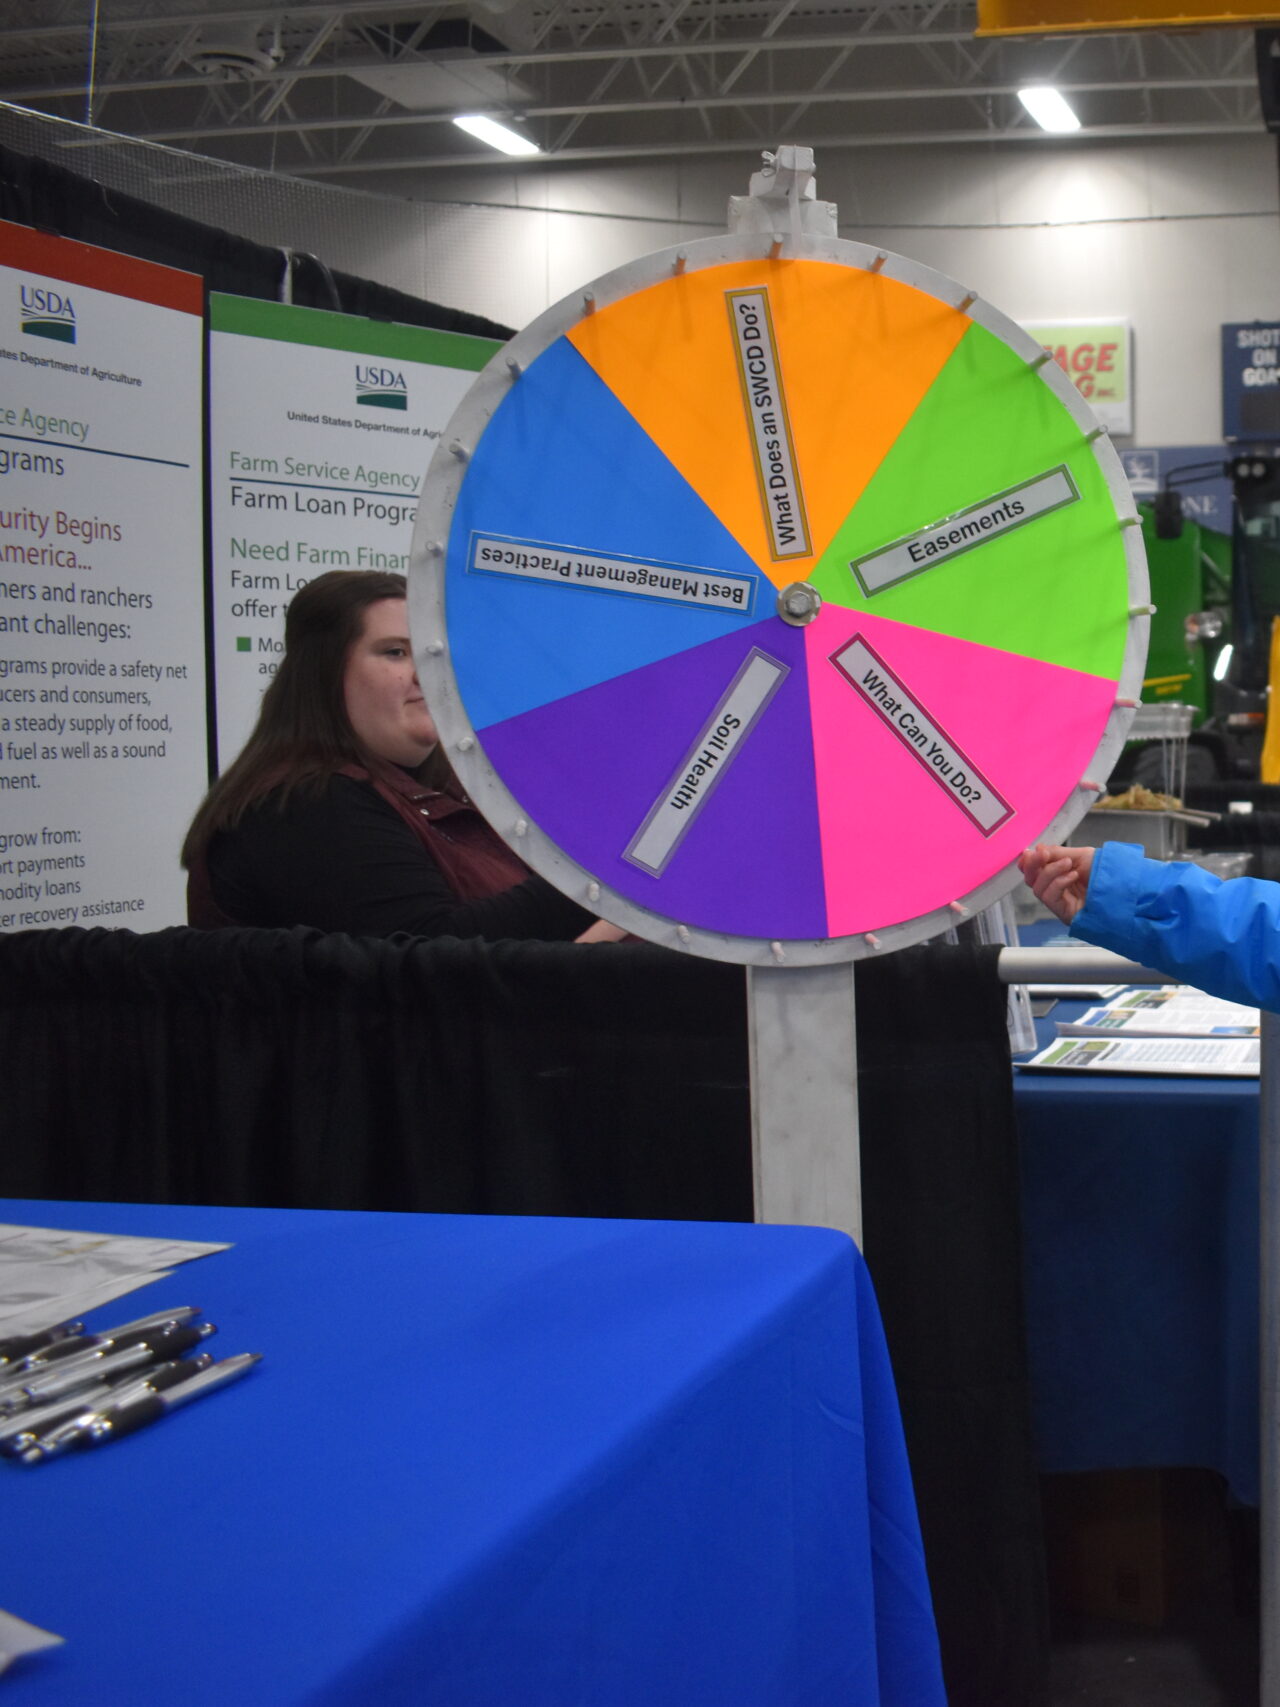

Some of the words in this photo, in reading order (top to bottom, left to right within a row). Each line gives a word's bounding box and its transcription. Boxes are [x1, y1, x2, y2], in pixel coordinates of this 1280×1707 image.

[20, 284, 76, 319] USDA
[739, 303, 761, 340] Do?
[20, 351, 78, 374] Department
[79, 365, 90, 376] of
[91, 367, 142, 387] Agriculture
[1043, 343, 1118, 372] AGE
[1252, 348, 1277, 367] ON
[355, 364, 408, 390] USDA
[746, 345, 773, 408] SWCD
[1242, 367, 1280, 387] GOA
[21, 407, 90, 443] Agency
[287, 410, 320, 424] United
[321, 414, 353, 428] States
[354, 419, 410, 435] Department
[411, 427, 421, 436] of
[761, 412, 777, 435] an
[230, 451, 279, 473] Farm
[284, 457, 350, 481] Service
[354, 465, 421, 492] Agency
[766, 439, 787, 489] Does
[231, 485, 288, 511] Farm
[295, 491, 346, 516] Loan
[55, 510, 122, 544] Begins
[773, 493, 797, 546] What
[907, 500, 1025, 563] Easements
[230, 537, 290, 561] Need
[297, 542, 350, 566] Farm
[481, 546, 571, 577] Practices
[231, 570, 280, 590] Farm
[286, 574, 312, 591] Lo
[576, 562, 698, 597] Management
[702, 582, 744, 604] Best
[41, 582, 76, 603] and
[80, 586, 153, 609] ranchers
[231, 599, 277, 618] offer
[34, 613, 132, 643] challenges:
[51, 658, 106, 678] provide
[109, 663, 118, 677] a
[121, 660, 163, 682] safety
[166, 664, 188, 679] net
[39, 685, 69, 703] and
[72, 690, 151, 706] consumers,
[1, 717, 11, 732] a
[15, 713, 66, 735] steady
[69, 714, 115, 735] supply
[118, 713, 133, 731] of
[136, 713, 173, 733] food,
[708, 713, 740, 751] Soil
[862, 668, 902, 717] What
[898, 712, 928, 748] Can
[926, 742, 953, 776] You
[949, 771, 982, 804] Do?
[7, 741, 37, 760] fuel
[41, 745, 58, 760] as
[61, 741, 90, 759] well
[93, 744, 108, 759] as
[111, 744, 119, 758] a
[122, 740, 166, 758] sound
[670, 749, 719, 810] Health
[0, 832, 38, 853] grow
[42, 826, 82, 845] from:
[17, 854, 86, 877] payments
[45, 879, 81, 897] loans
[20, 904, 79, 924] recovery
[81, 897, 145, 918] assistance
